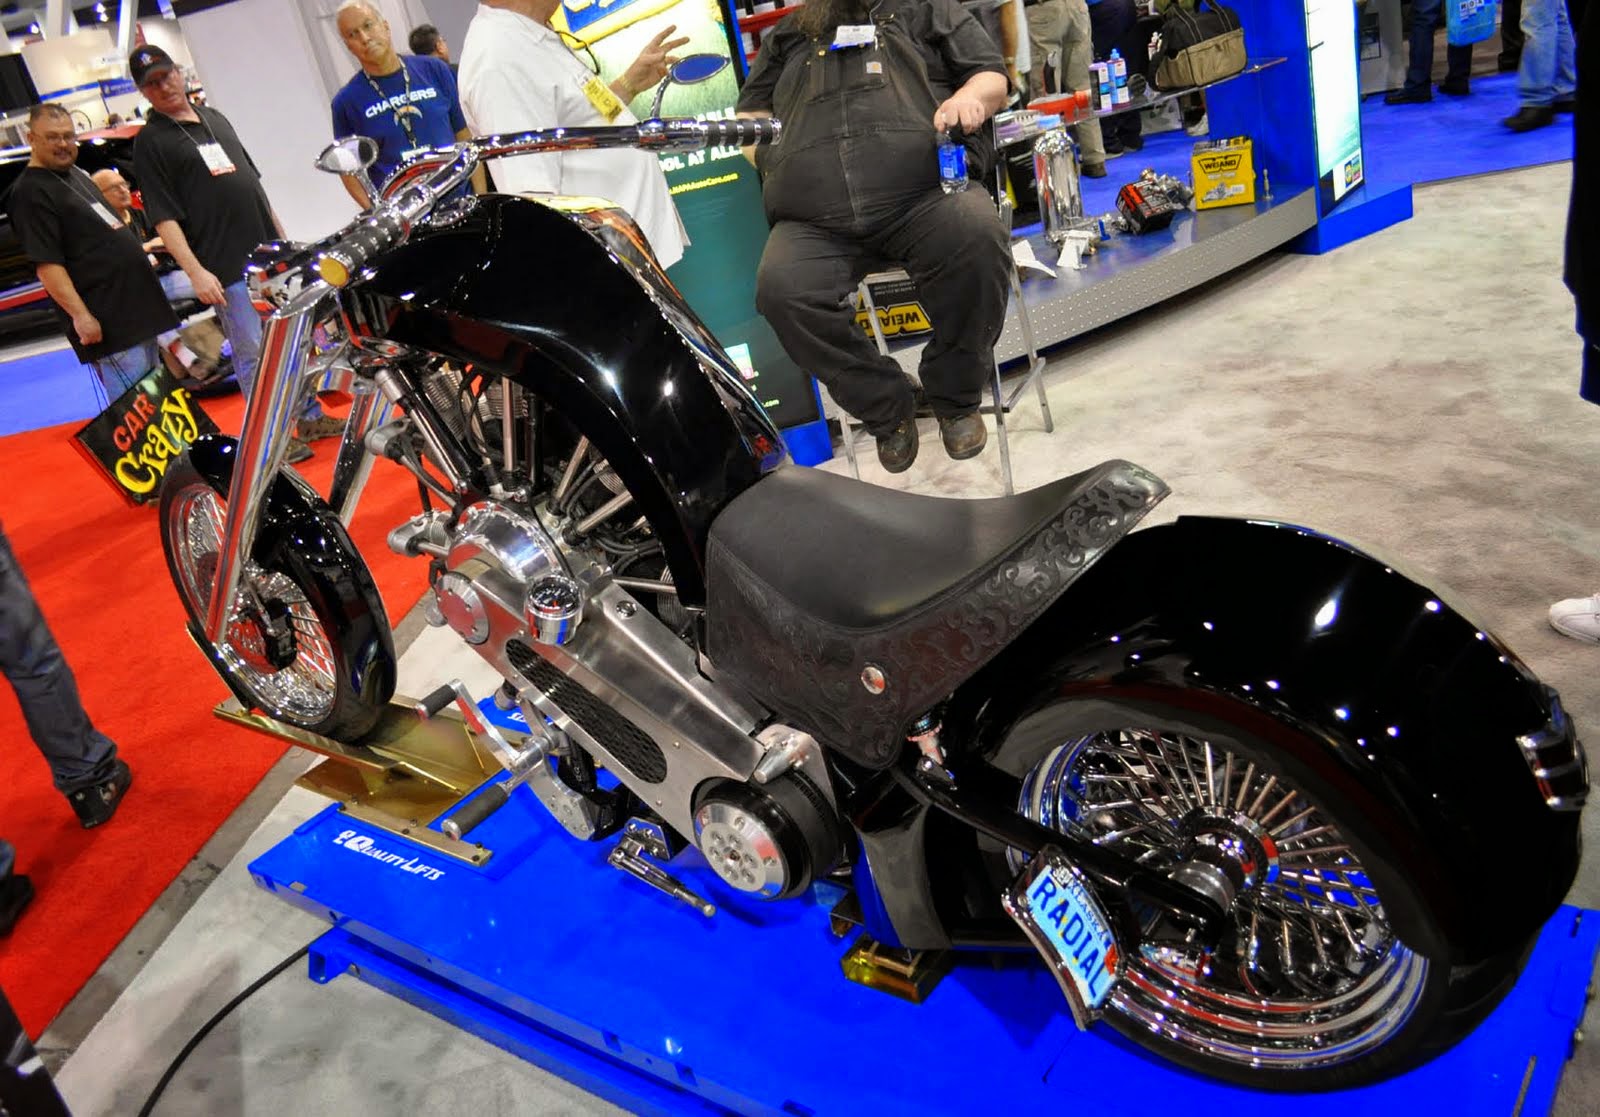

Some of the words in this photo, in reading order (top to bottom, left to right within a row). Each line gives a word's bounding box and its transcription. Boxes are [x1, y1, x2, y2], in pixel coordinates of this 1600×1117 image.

[365, 88, 437, 118] CHARGERS
[694, 106, 736, 122] ABLE
[688, 150, 705, 166] AT
[1204, 160, 1237, 169] WEIAND
[861, 311, 921, 330] WEIAD
[113, 393, 156, 452] CAR
[115, 388, 198, 493] Crazy
[1032, 876, 1105, 998] RADIAL
